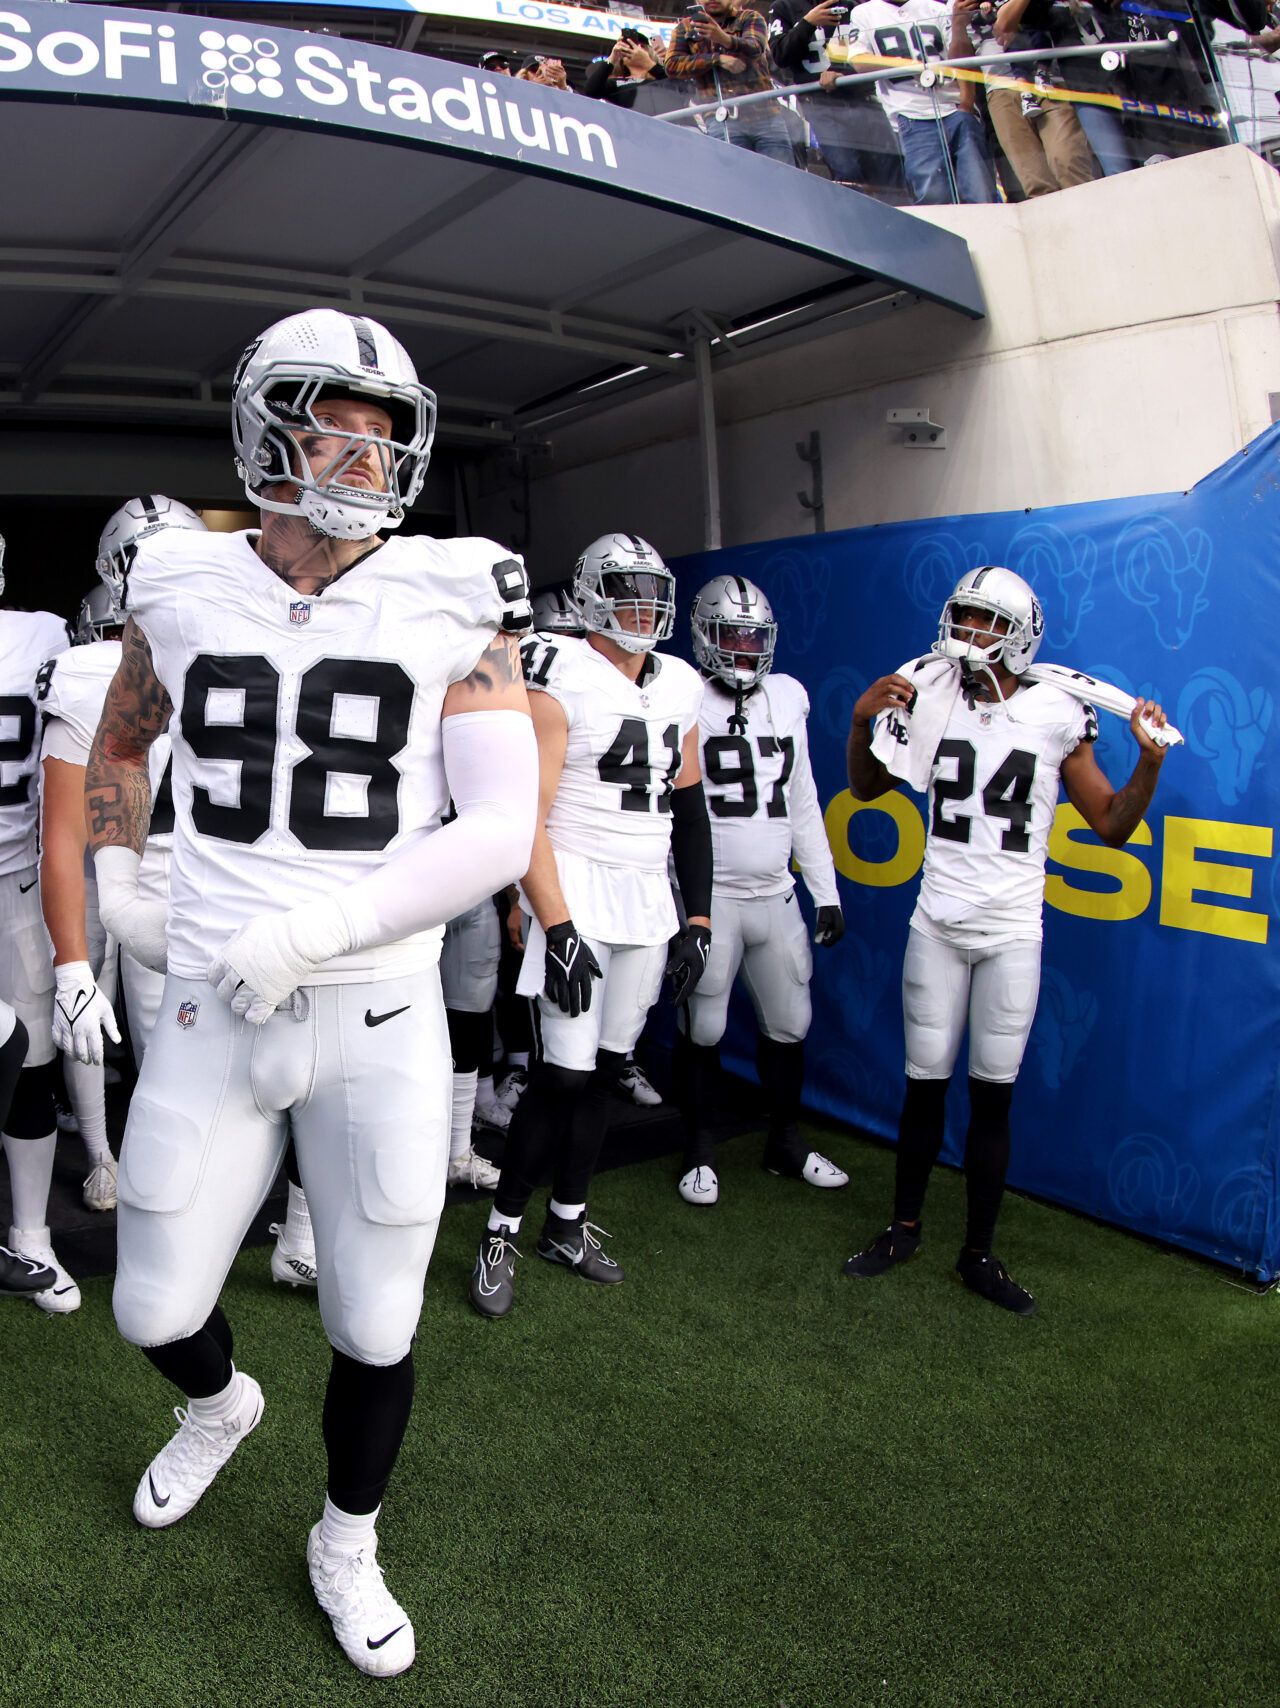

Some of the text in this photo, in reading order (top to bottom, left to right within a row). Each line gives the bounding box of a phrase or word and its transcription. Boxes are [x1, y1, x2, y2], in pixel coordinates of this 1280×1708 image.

[496, 1, 570, 25] LOS
[293, 45, 618, 169] Stadium
[357, 365, 386, 378] AIDERS
[180, 651, 419, 854] 98
[597, 718, 682, 814] 41
[702, 735, 795, 818] 97
[930, 737, 1039, 854] 24
